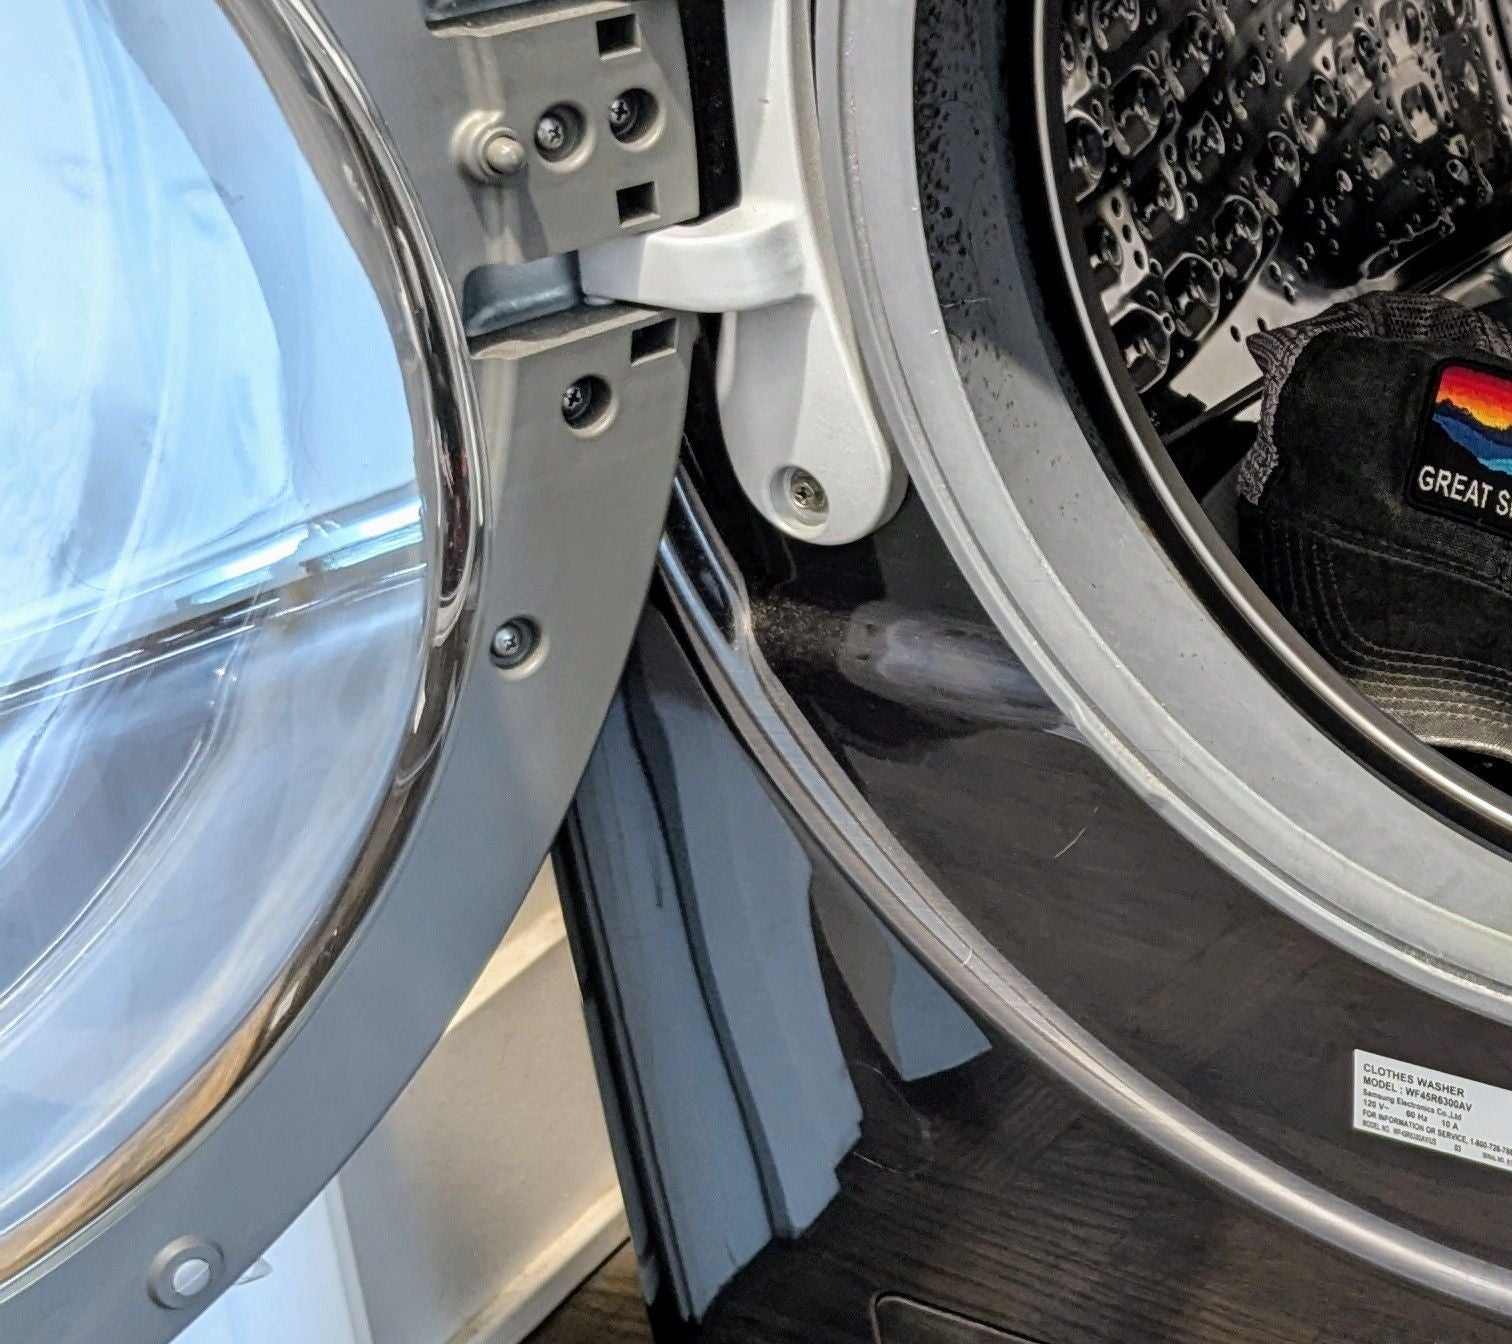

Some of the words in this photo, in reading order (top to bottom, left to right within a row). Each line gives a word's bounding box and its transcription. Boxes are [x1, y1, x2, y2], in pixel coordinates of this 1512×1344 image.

[1417, 465, 1494, 509] GREAT
[1363, 1063, 1414, 1084] CLOTHES
[1416, 1076, 1465, 1097] WASHER
[1363, 1076, 1397, 1092] MODEL
[1363, 1088, 1395, 1104] Samsung
